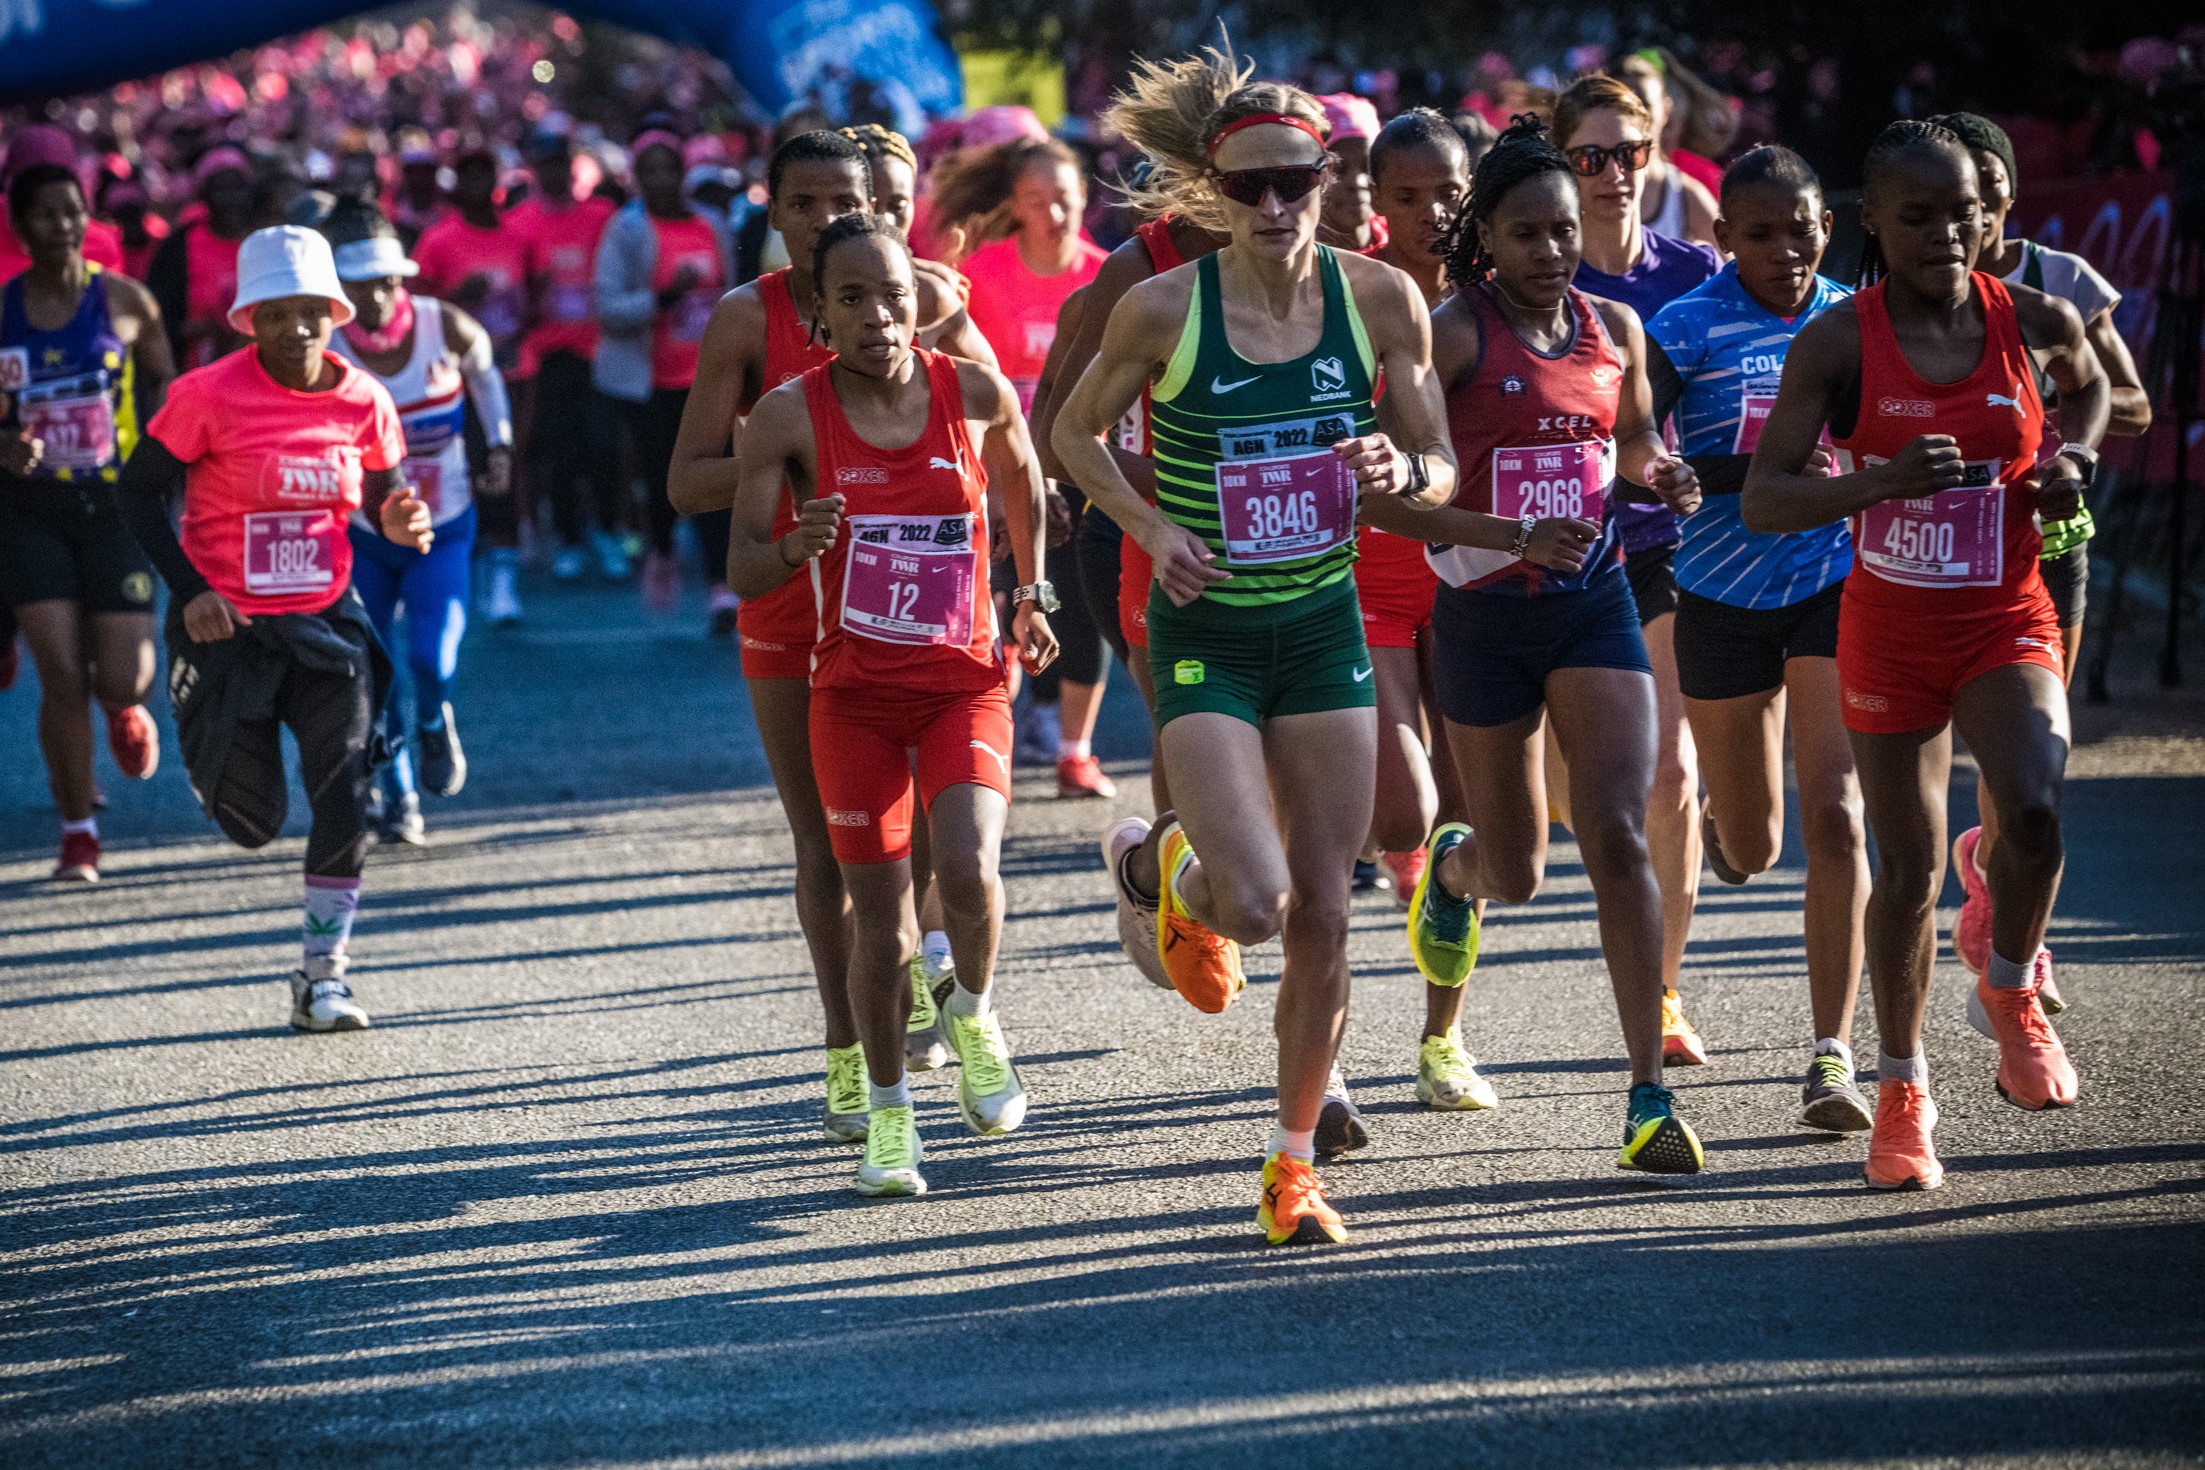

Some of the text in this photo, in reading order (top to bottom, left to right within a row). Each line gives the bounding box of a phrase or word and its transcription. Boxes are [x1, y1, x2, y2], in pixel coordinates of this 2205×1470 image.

[1741, 354, 1786, 374] COL
[1310, 391, 1351, 402] NEDBANK
[1878, 397, 1935, 417] BOXER
[1315, 422, 1345, 436] ASA
[1538, 416, 1592, 430] XCEL
[1274, 428, 1308, 448] 2022
[1234, 439, 1265, 455] AGN
[1535, 456, 1563, 469] TWR
[836, 467, 889, 486] BOXER
[1260, 470, 1292, 484] TWR
[1965, 467, 1988, 481] SA
[1518, 477, 1583, 520] 2968
[1246, 490, 1318, 539] 3846
[899, 524, 932, 542] 2022
[939, 520, 965, 535] ASA
[859, 529, 890, 544] AGN
[1884, 517, 1955, 563] 4500
[267, 538, 320, 573] 1802
[890, 558, 920, 574] TWR
[888, 581, 920, 621] 12
